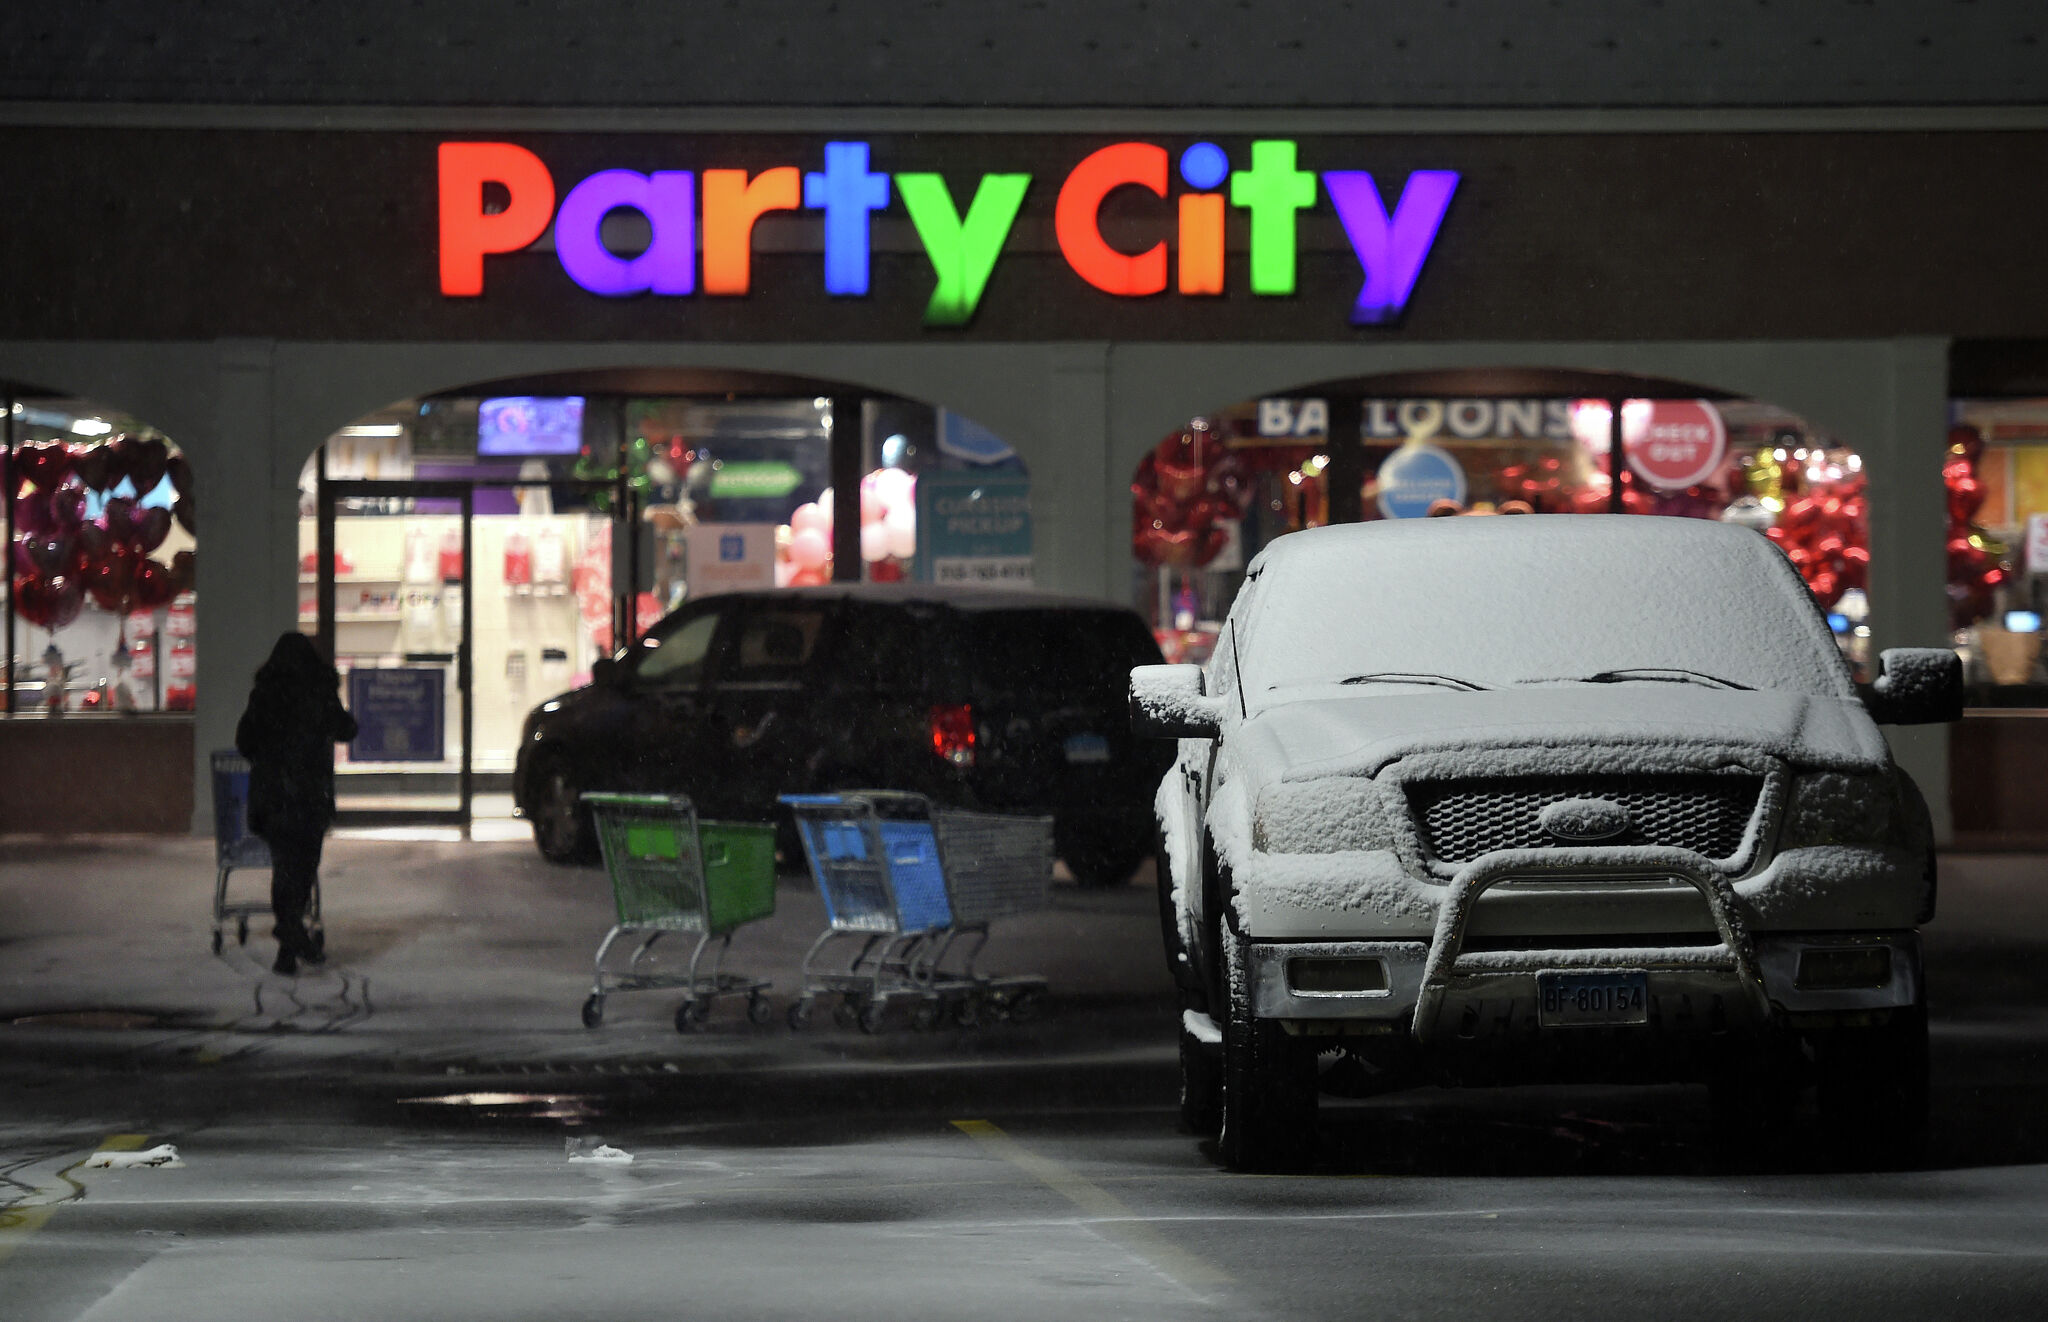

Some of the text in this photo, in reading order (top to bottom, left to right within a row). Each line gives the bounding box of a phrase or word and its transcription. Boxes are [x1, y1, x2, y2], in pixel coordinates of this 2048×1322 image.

[437, 139, 1461, 327] Party City
[1258, 398, 1572, 438] BALOONS
